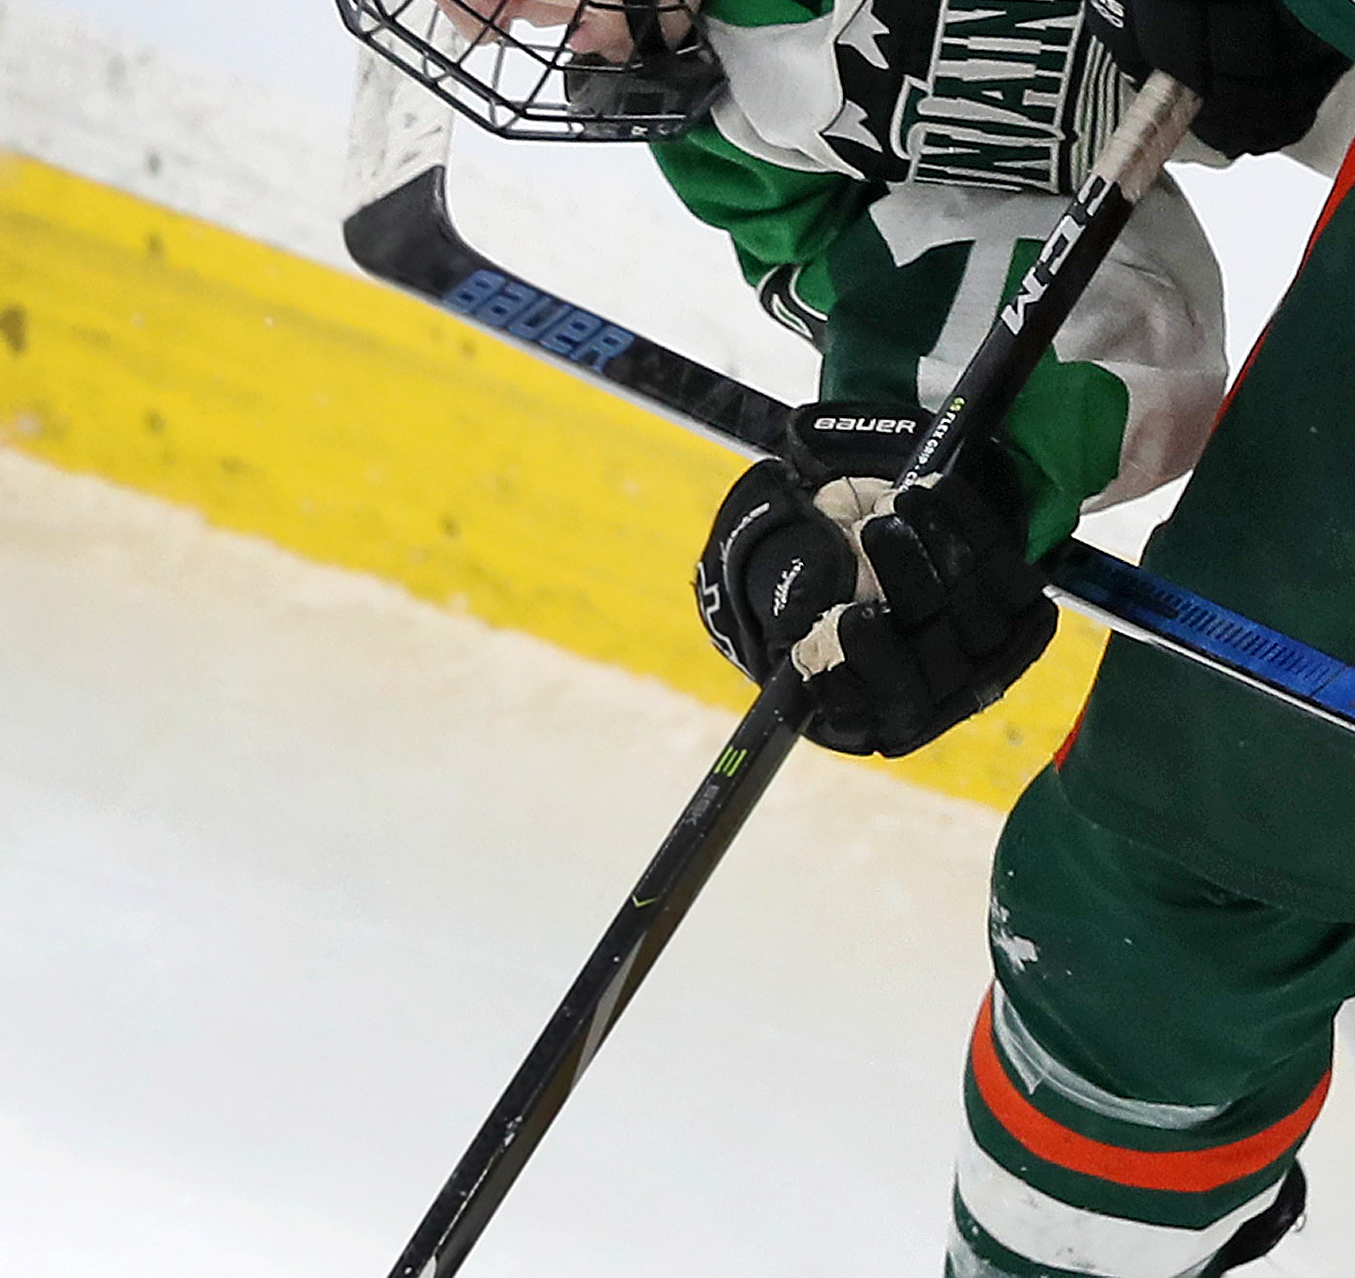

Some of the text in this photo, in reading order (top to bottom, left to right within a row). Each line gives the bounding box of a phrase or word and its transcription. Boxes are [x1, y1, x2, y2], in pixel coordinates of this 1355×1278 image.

[443, 268, 635, 374] BAUER
[814, 416, 917, 434] BAUER
[934, 411, 957, 440] FLEX
